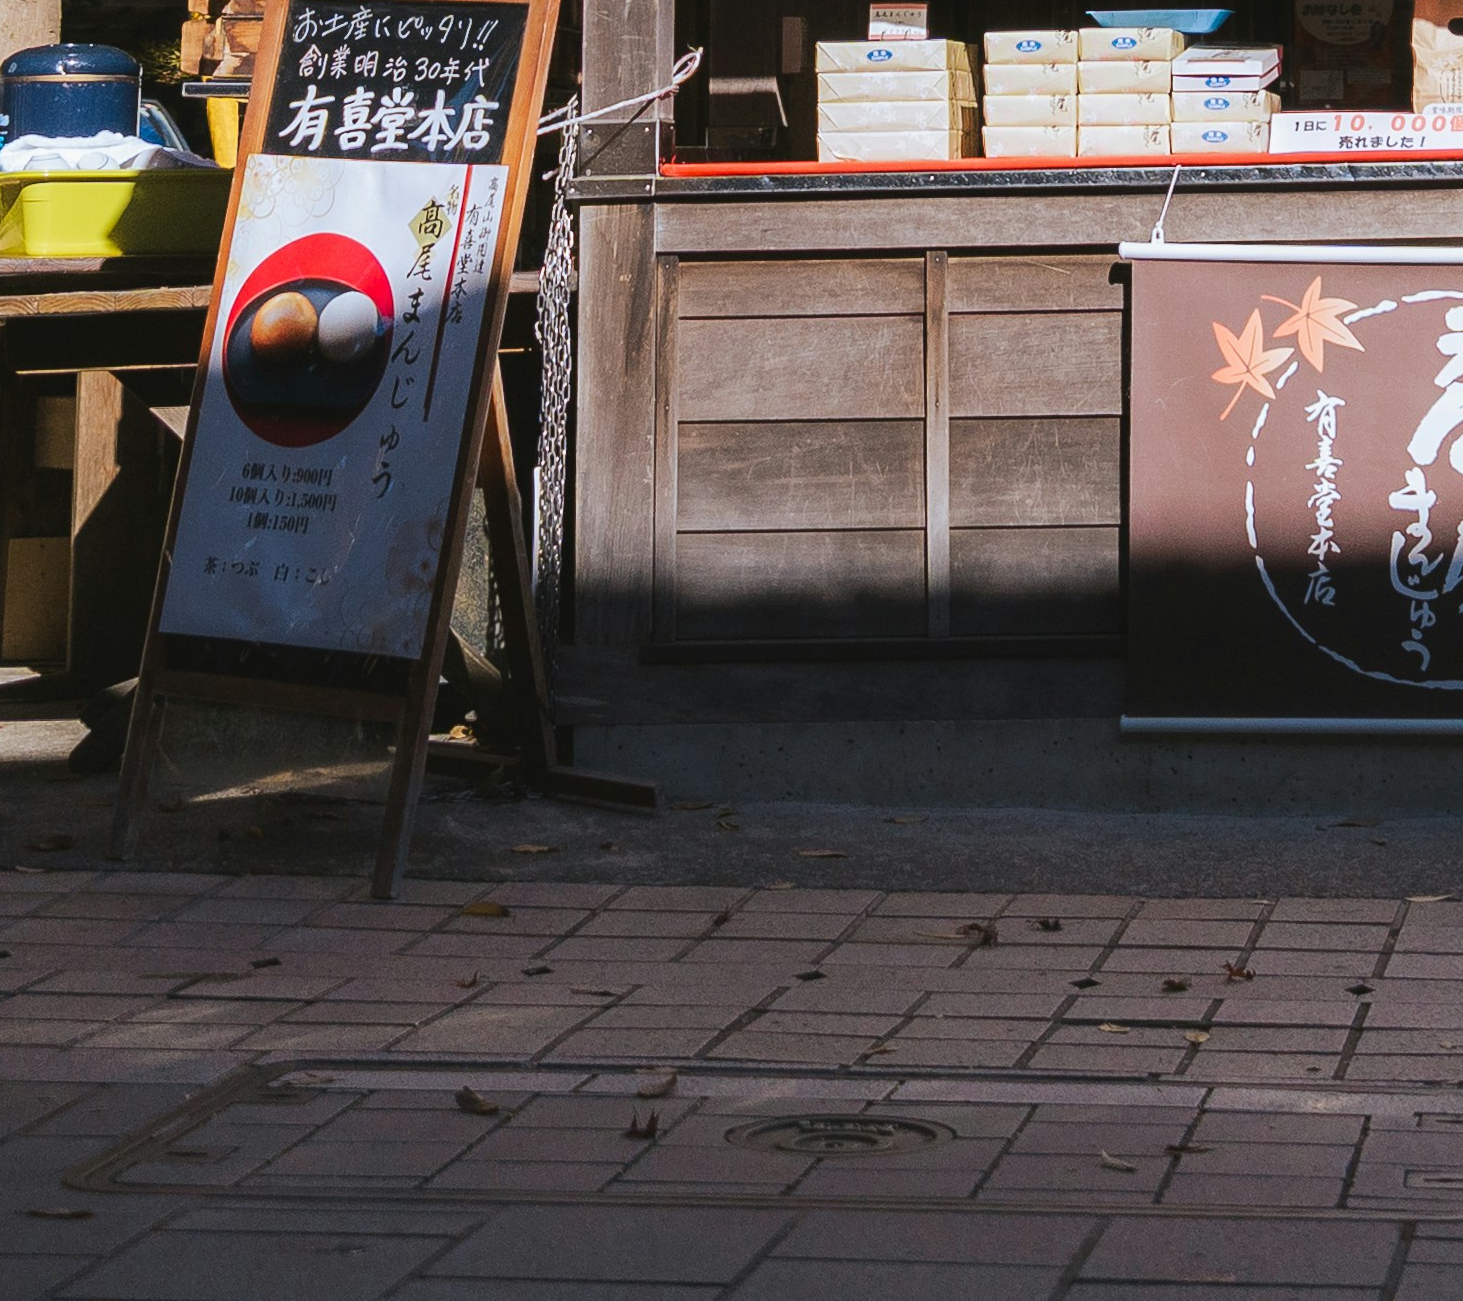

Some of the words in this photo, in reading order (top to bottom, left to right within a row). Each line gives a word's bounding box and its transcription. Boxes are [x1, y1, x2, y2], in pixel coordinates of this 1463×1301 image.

[298, 43, 490, 87] 創業明治30年代
[279, 84, 499, 153] 有喜堂本店
[443, 203, 483, 325] 有喜堂本店
[1303, 388, 1347, 609] 有喜堂本店
